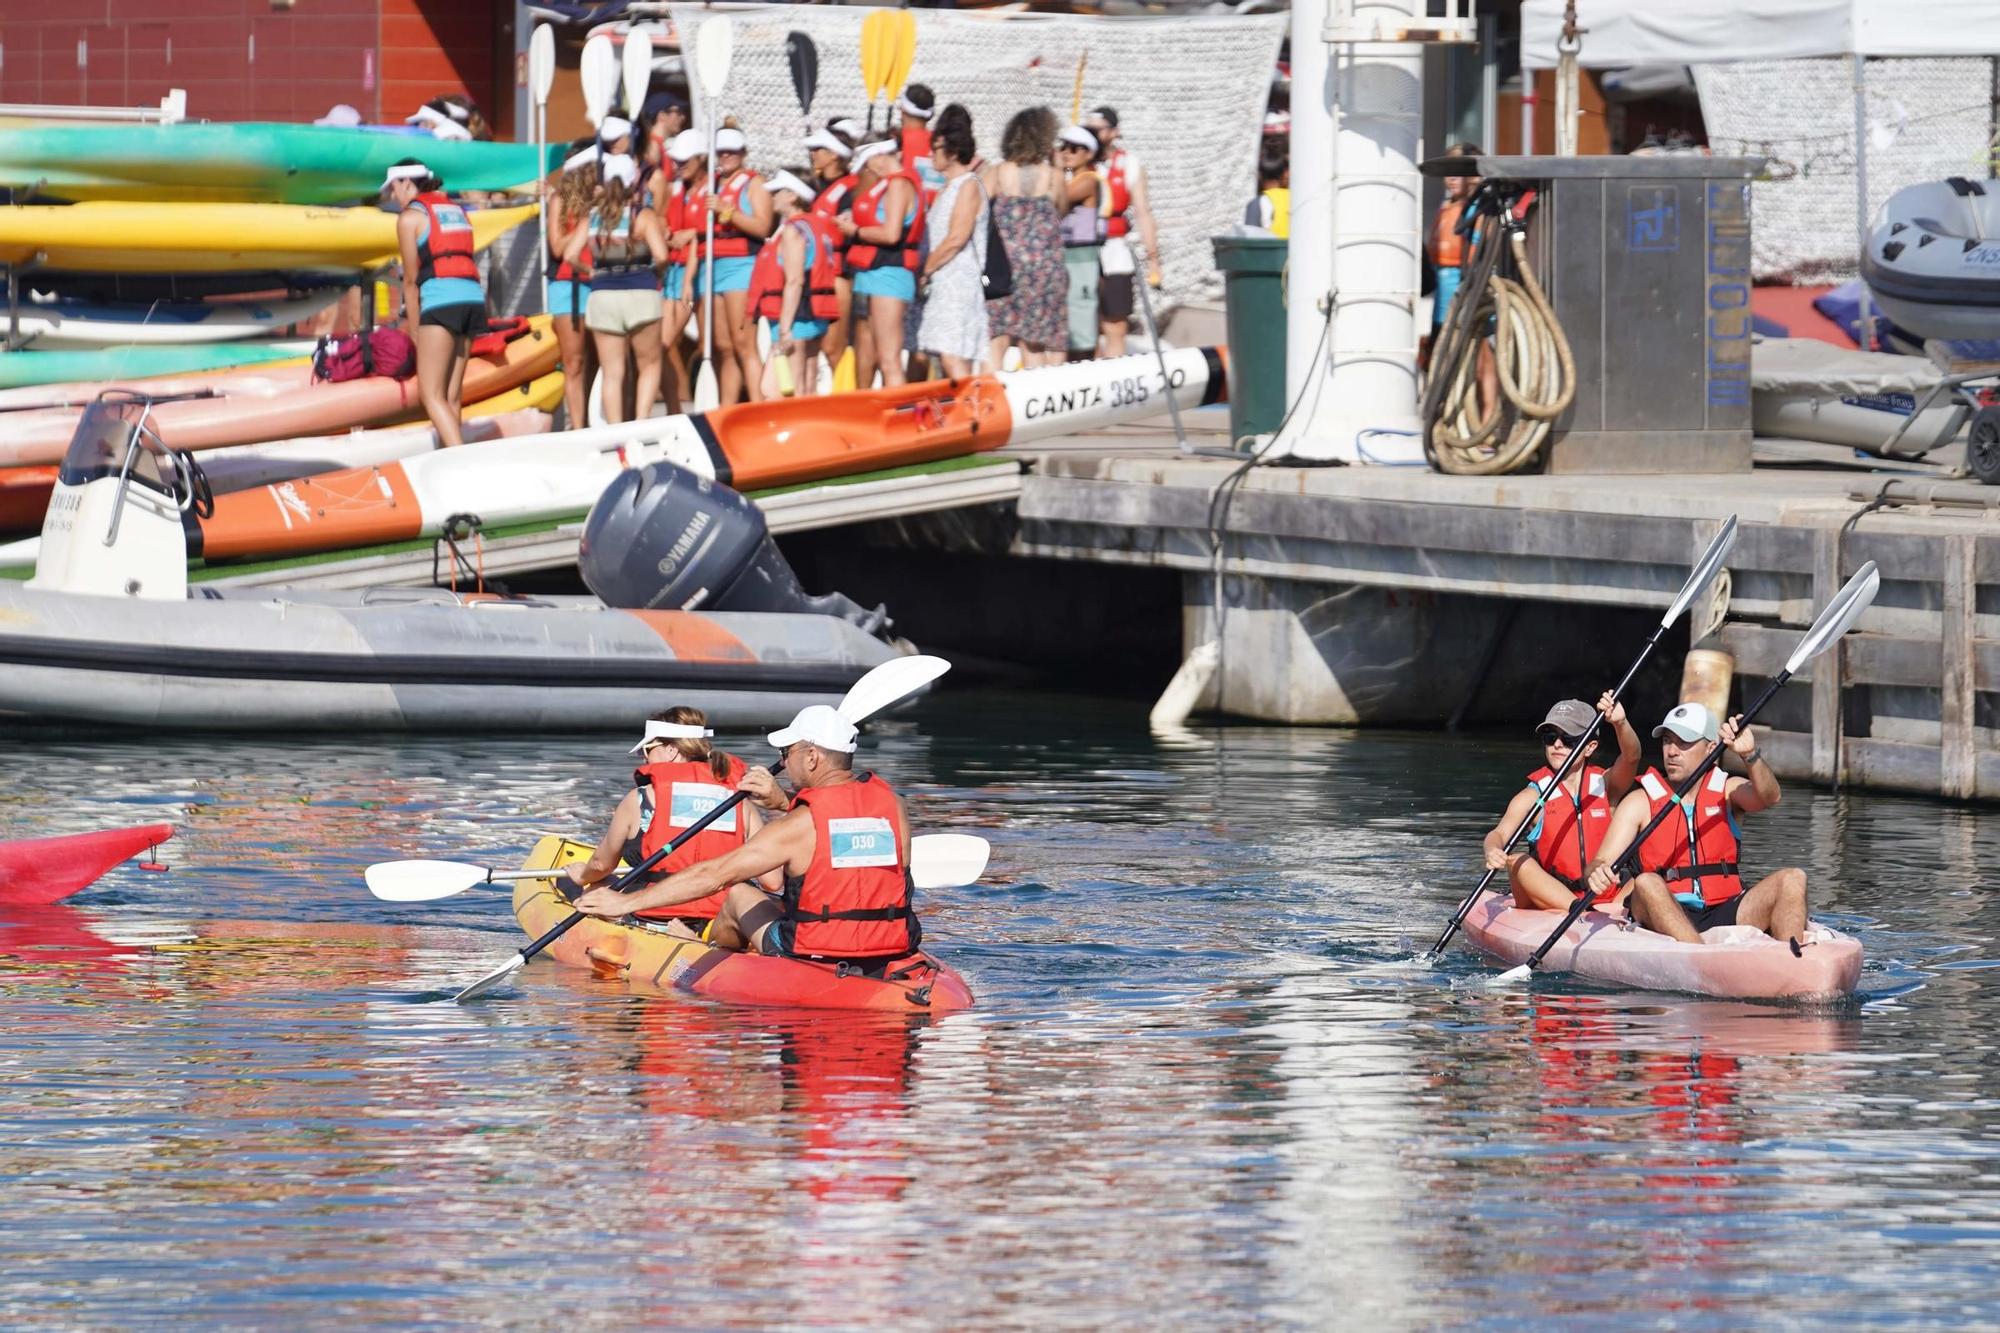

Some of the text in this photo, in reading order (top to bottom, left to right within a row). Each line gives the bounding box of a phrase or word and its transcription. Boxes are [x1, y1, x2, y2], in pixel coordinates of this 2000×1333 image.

[1110, 375, 1149, 408] 385
[667, 510, 711, 562] YAMAHA
[851, 835, 875, 849] 030
